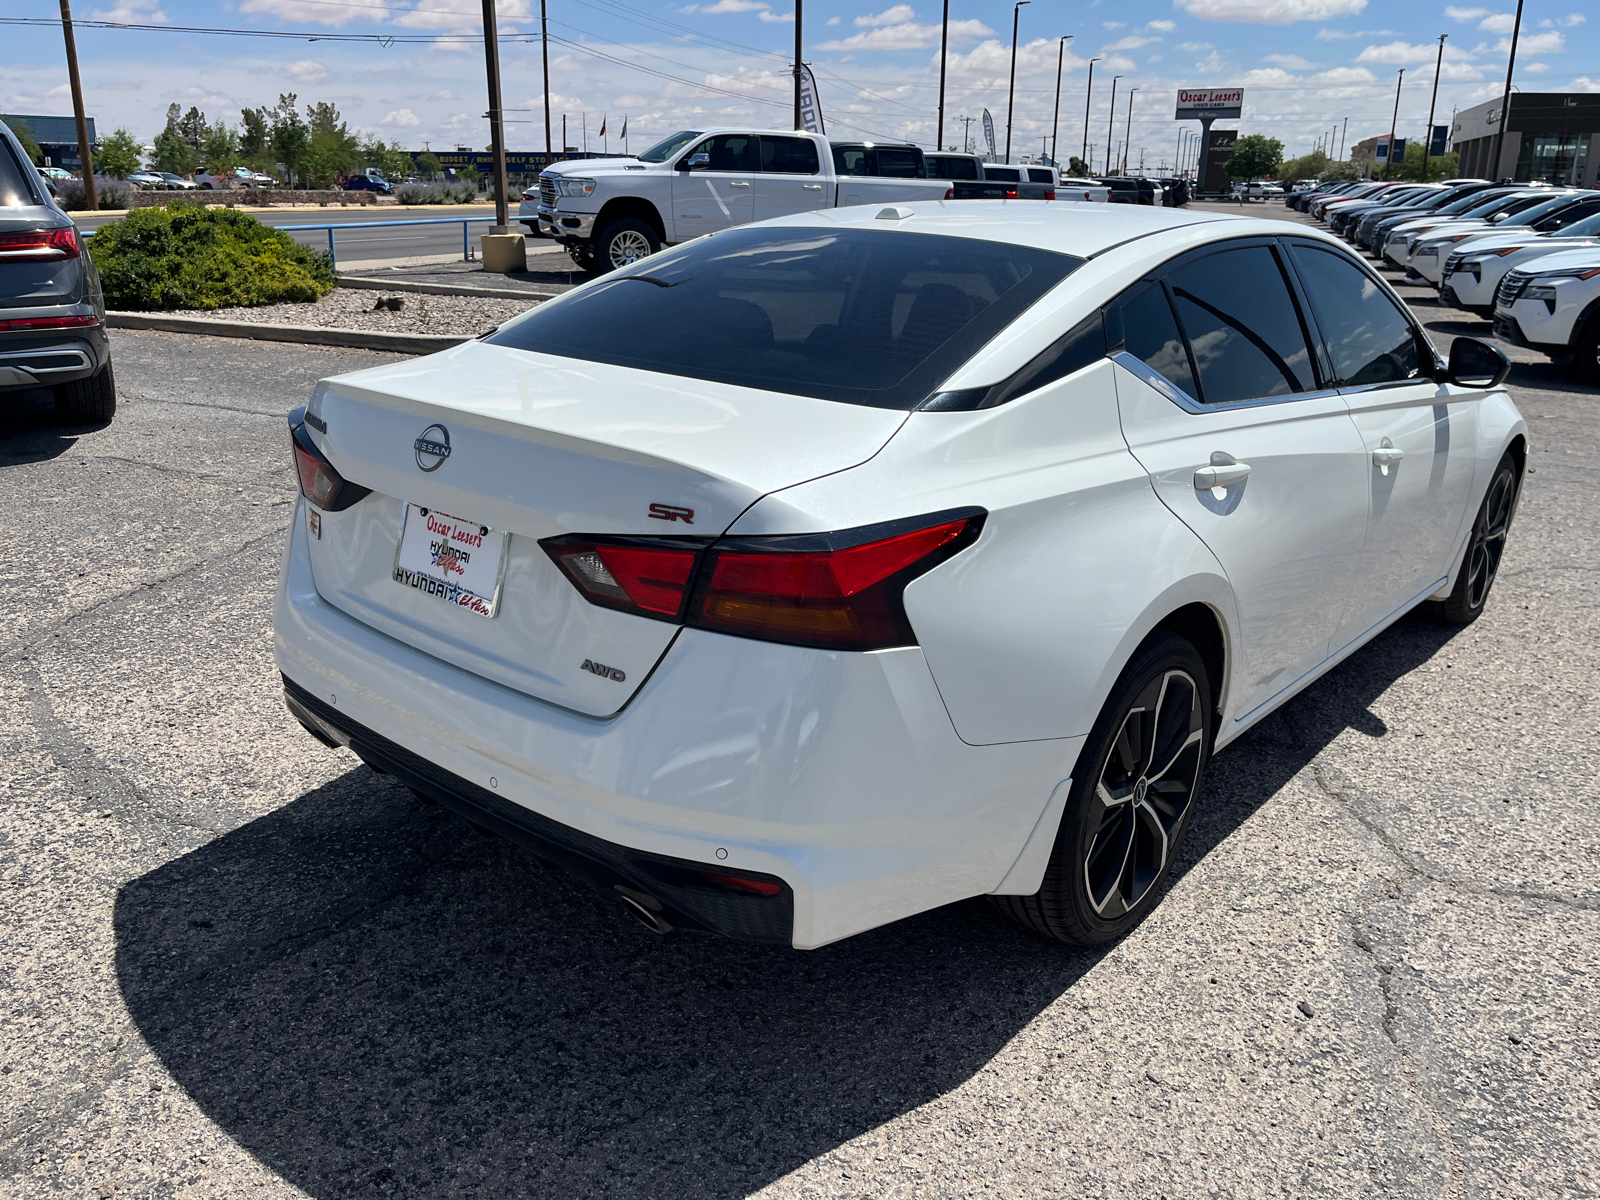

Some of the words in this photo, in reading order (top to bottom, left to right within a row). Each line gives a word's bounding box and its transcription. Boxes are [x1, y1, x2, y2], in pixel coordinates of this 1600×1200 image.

[1180, 90, 1208, 103] Oscar
[1208, 90, 1241, 102] Leeser's
[414, 439, 450, 456] NISSAN
[647, 502, 695, 525] SR
[426, 514, 451, 538] Oscar
[450, 524, 483, 548] Leeser's
[429, 540, 471, 564] HYUNDAI
[395, 567, 449, 600] HYUNDAI
[459, 594, 474, 607] El
[470, 598, 490, 616] Paso
[580, 658, 626, 682] AWD
